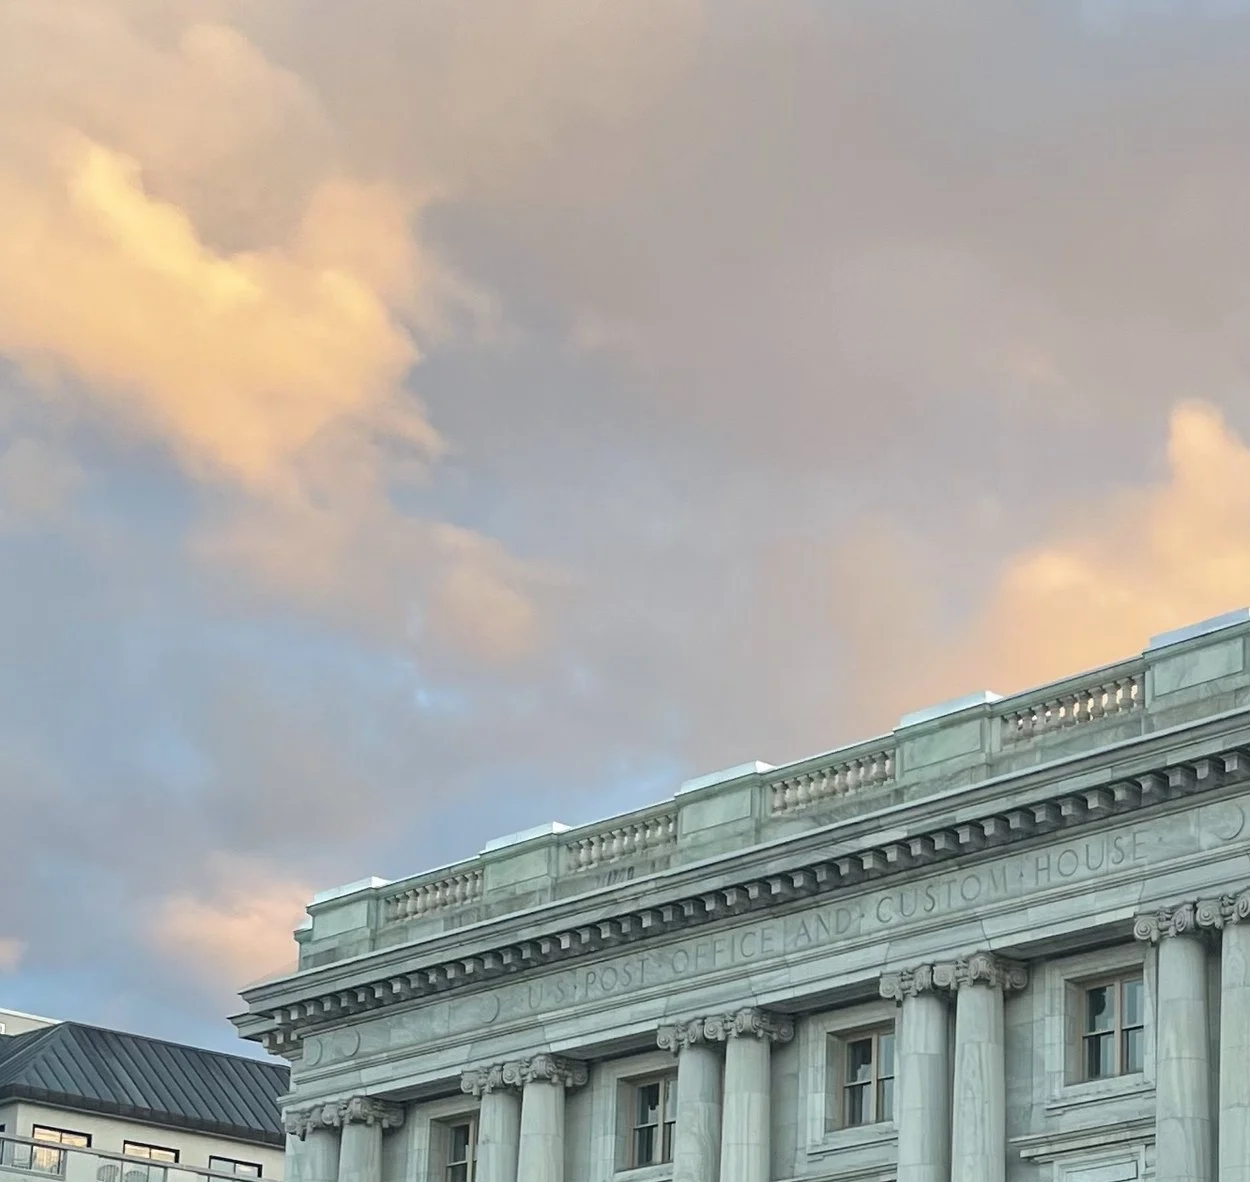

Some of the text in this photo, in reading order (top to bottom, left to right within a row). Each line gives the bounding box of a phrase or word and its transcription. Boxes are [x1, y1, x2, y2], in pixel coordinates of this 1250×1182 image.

[585, 957, 649, 997] POST
[671, 926, 774, 974] OFFICE
[793, 907, 851, 946] AND
[876, 864, 1008, 923] CUSTOM
[1034, 829, 1148, 885] HOUSE
